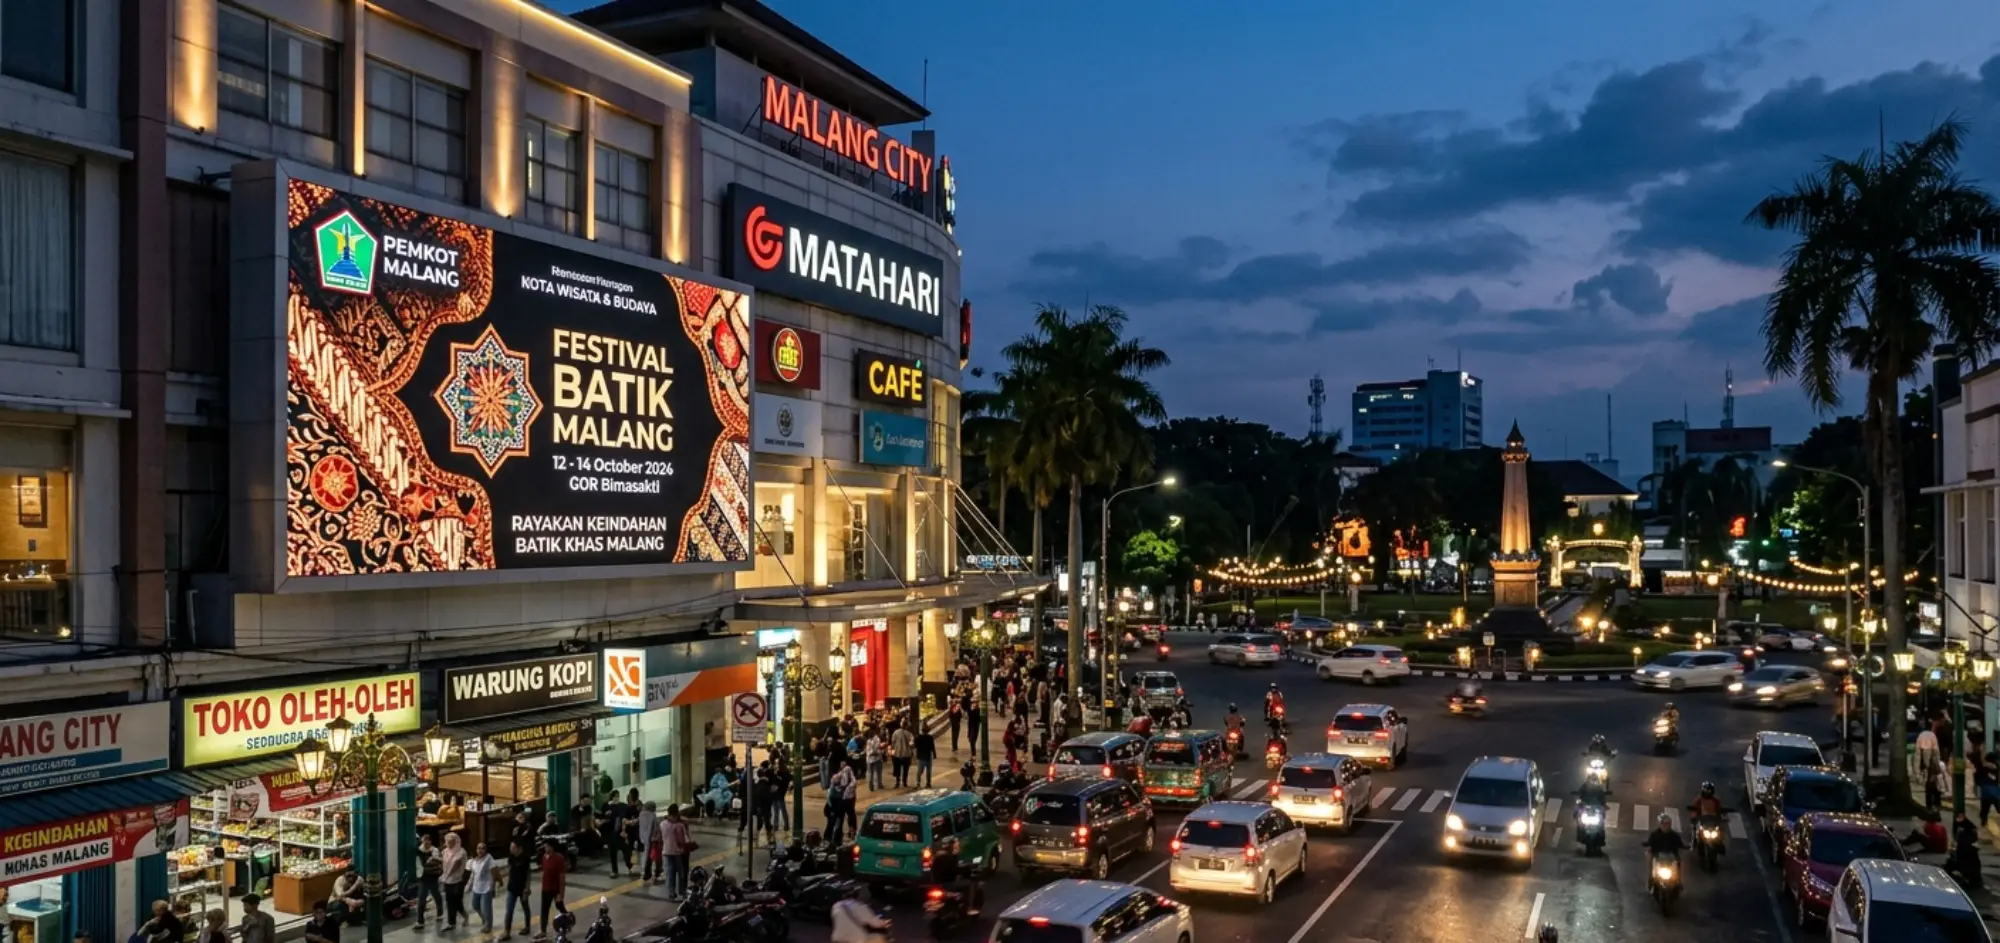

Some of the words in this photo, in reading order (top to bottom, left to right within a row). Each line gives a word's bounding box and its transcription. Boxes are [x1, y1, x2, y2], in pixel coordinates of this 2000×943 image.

[765, 75, 879, 171] MALANG
[884, 138, 932, 193] CITY
[383, 235, 459, 267] PEMKOT
[383, 257, 460, 288] MALANG
[789, 227, 940, 316] MATAHARI
[521, 275, 555, 294] KOTA
[613, 295, 657, 315] BUDAYA
[553, 328, 674, 374] FESTIVAL
[553, 363, 674, 419] BATIK
[553, 412, 674, 452] MALANG
[552, 455, 567, 470] 12
[576, 456, 591, 472] 14
[594, 457, 643, 474] October
[644, 461, 674, 476] 2026
[569, 476, 598, 491] GOR
[601, 477, 660, 493] Bimasakti
[512, 515, 583, 532] RAYAKAN
[587, 516, 666, 532] KEINDAHAN
[516, 537, 561, 553] BATIK
[565, 536, 603, 552] KHAS
[607, 536, 664, 552] MALANG
[453, 666, 544, 701] WARUNG
[549, 660, 593, 688] KOPI
[193, 696, 271, 737] TOKO
[280, 678, 414, 726] OLEH-OLEH
[64, 713, 122, 750] CITY
[52, 841, 110, 866] MALANG
